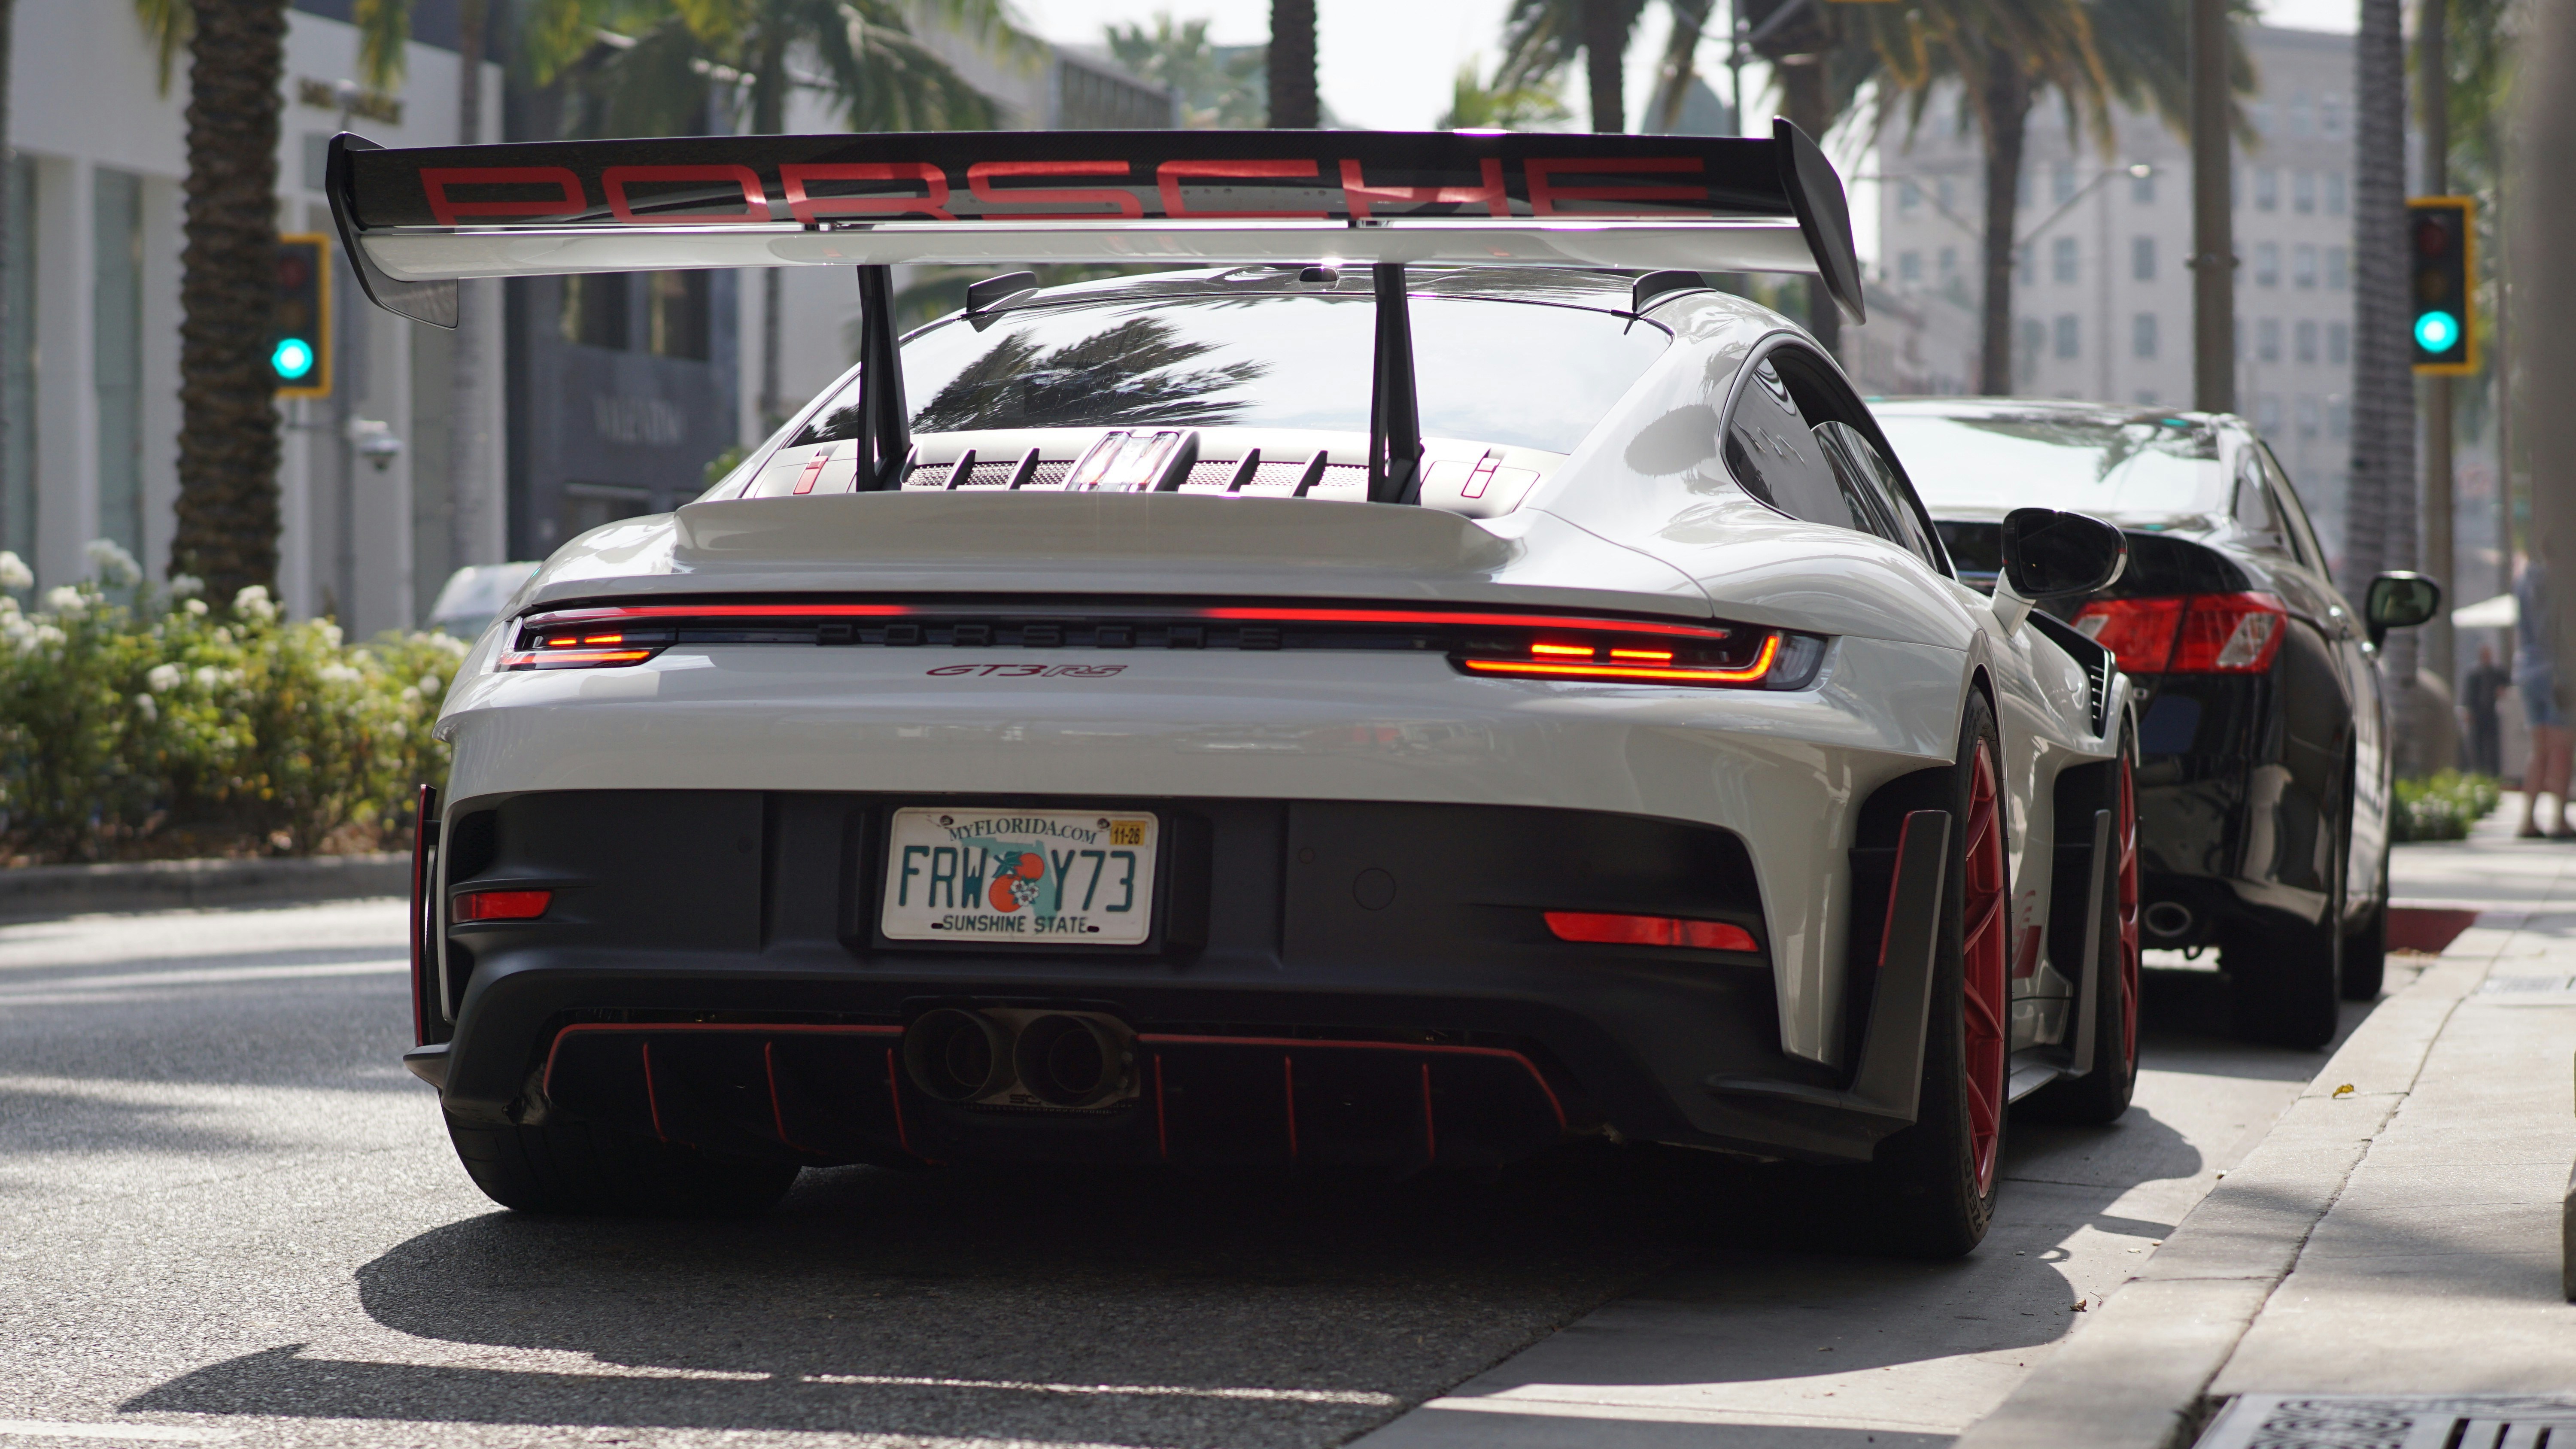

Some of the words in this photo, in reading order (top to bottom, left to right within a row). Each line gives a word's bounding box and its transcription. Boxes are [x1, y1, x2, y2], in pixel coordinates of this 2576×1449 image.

[419, 157, 1713, 225] PORSCHE
[815, 624, 1282, 649] PORSCHE
[948, 817, 1097, 845] MYFLORIDA.COM
[899, 845, 989, 909] FRW
[1051, 849, 1136, 912] Y73
[942, 914, 1027, 933] SUNSHINE
[1034, 916, 1088, 934] STATE
